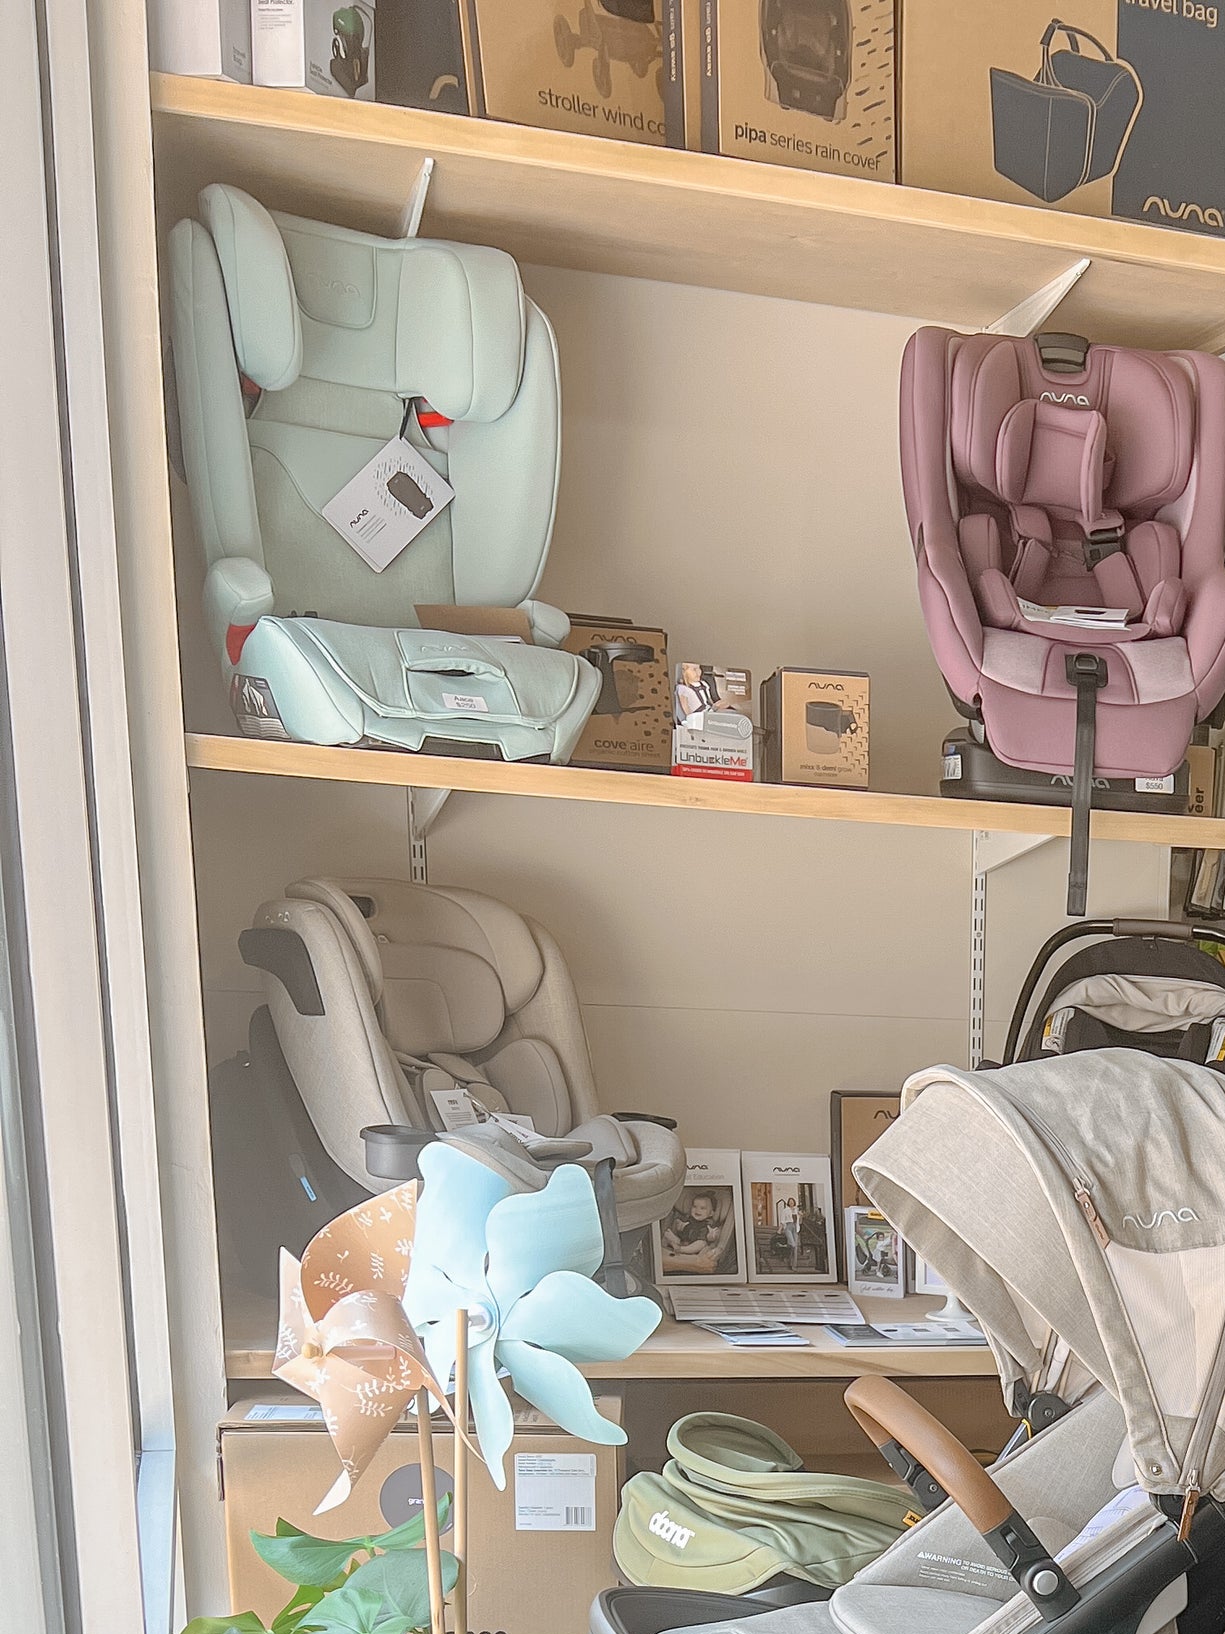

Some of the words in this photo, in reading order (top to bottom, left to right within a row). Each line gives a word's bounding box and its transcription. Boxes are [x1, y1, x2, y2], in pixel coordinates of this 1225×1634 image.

[1182, 0, 1219, 28] bag
[538, 88, 599, 118] stroller
[602, 106, 644, 131] wind
[734, 122, 767, 143] pipa
[770, 131, 812, 154] series
[815, 143, 840, 161] rain
[844, 150, 882, 172] cover
[1142, 196, 1225, 228] nuna
[1039, 390, 1090, 407] nuna
[349, 508, 370, 529] nuna
[590, 633, 638, 644] nuna
[808, 682, 845, 691] nuna
[593, 738, 628, 751] cove
[629, 740, 655, 751] aire
[679, 751, 748, 768] UnbuckleMe
[772, 1165, 801, 1174] nuna
[1121, 1207, 1201, 1230] nuna
[648, 1509, 696, 1550] doona
[923, 1552, 962, 1566] WARNING
